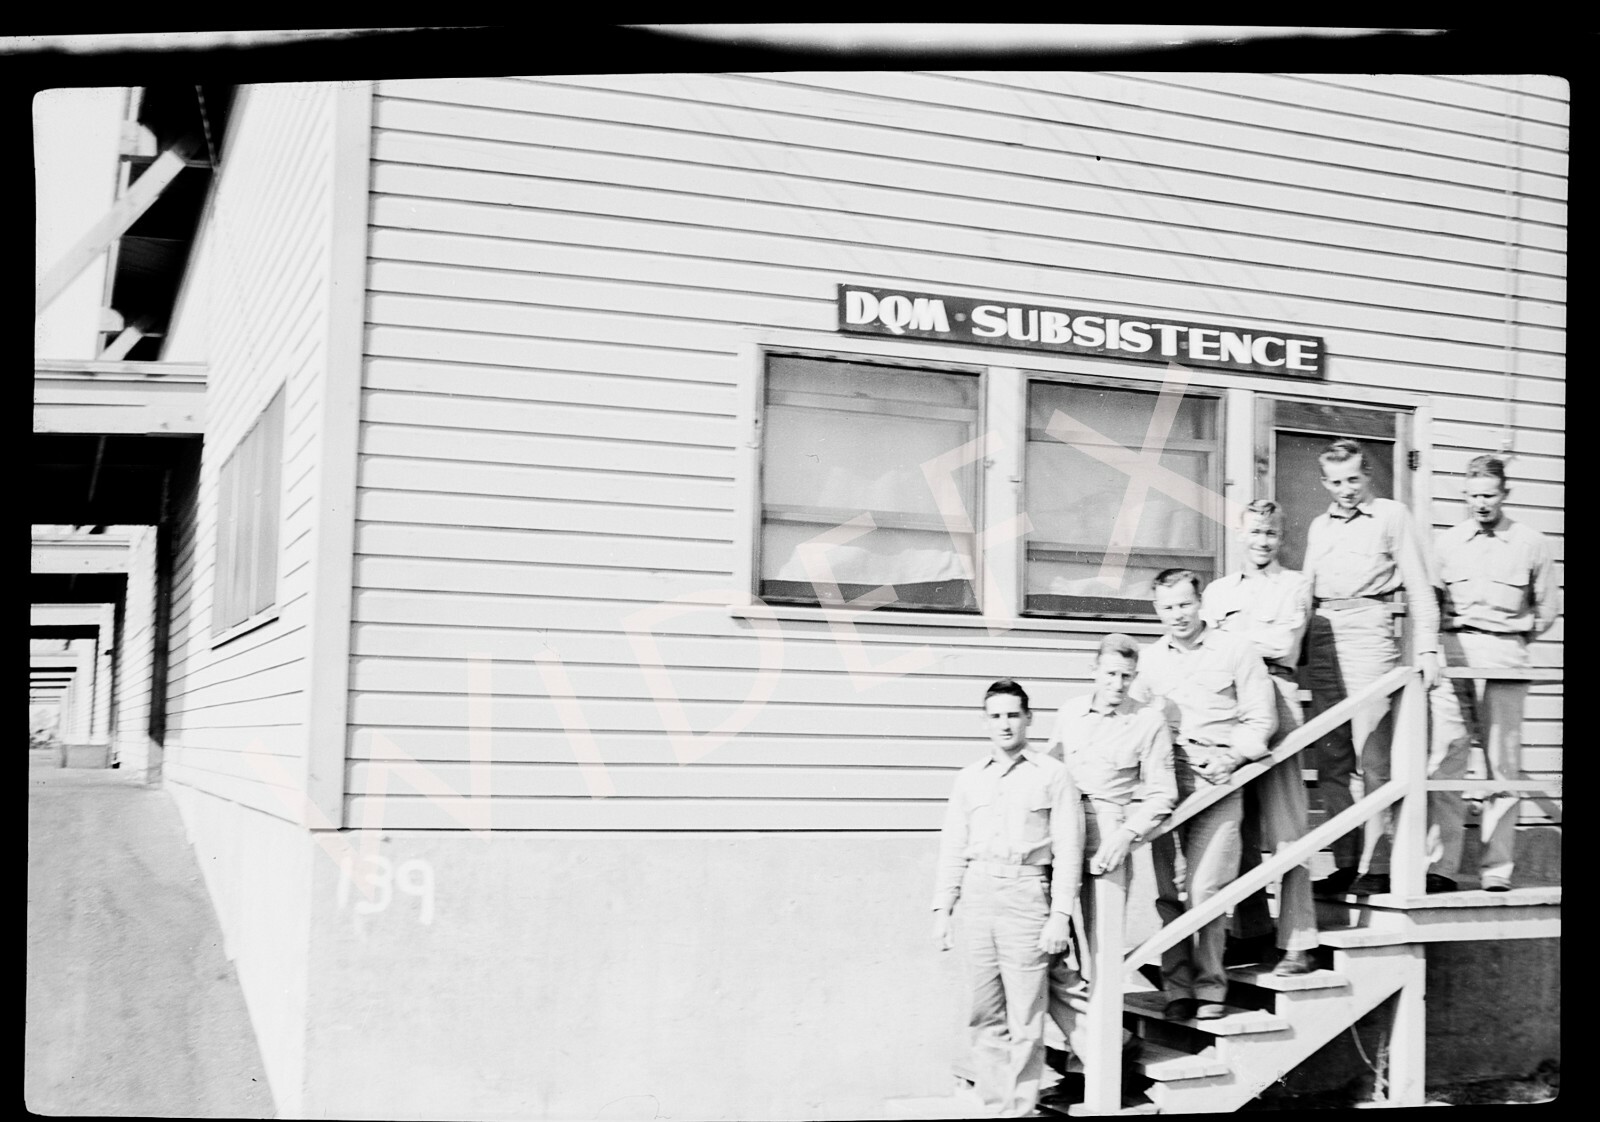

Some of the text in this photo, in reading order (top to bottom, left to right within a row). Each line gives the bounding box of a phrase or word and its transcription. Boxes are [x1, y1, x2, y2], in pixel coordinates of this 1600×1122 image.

[845, 290, 1318, 372] DQM SUBSISTENCE
[337, 855, 435, 925] 139
